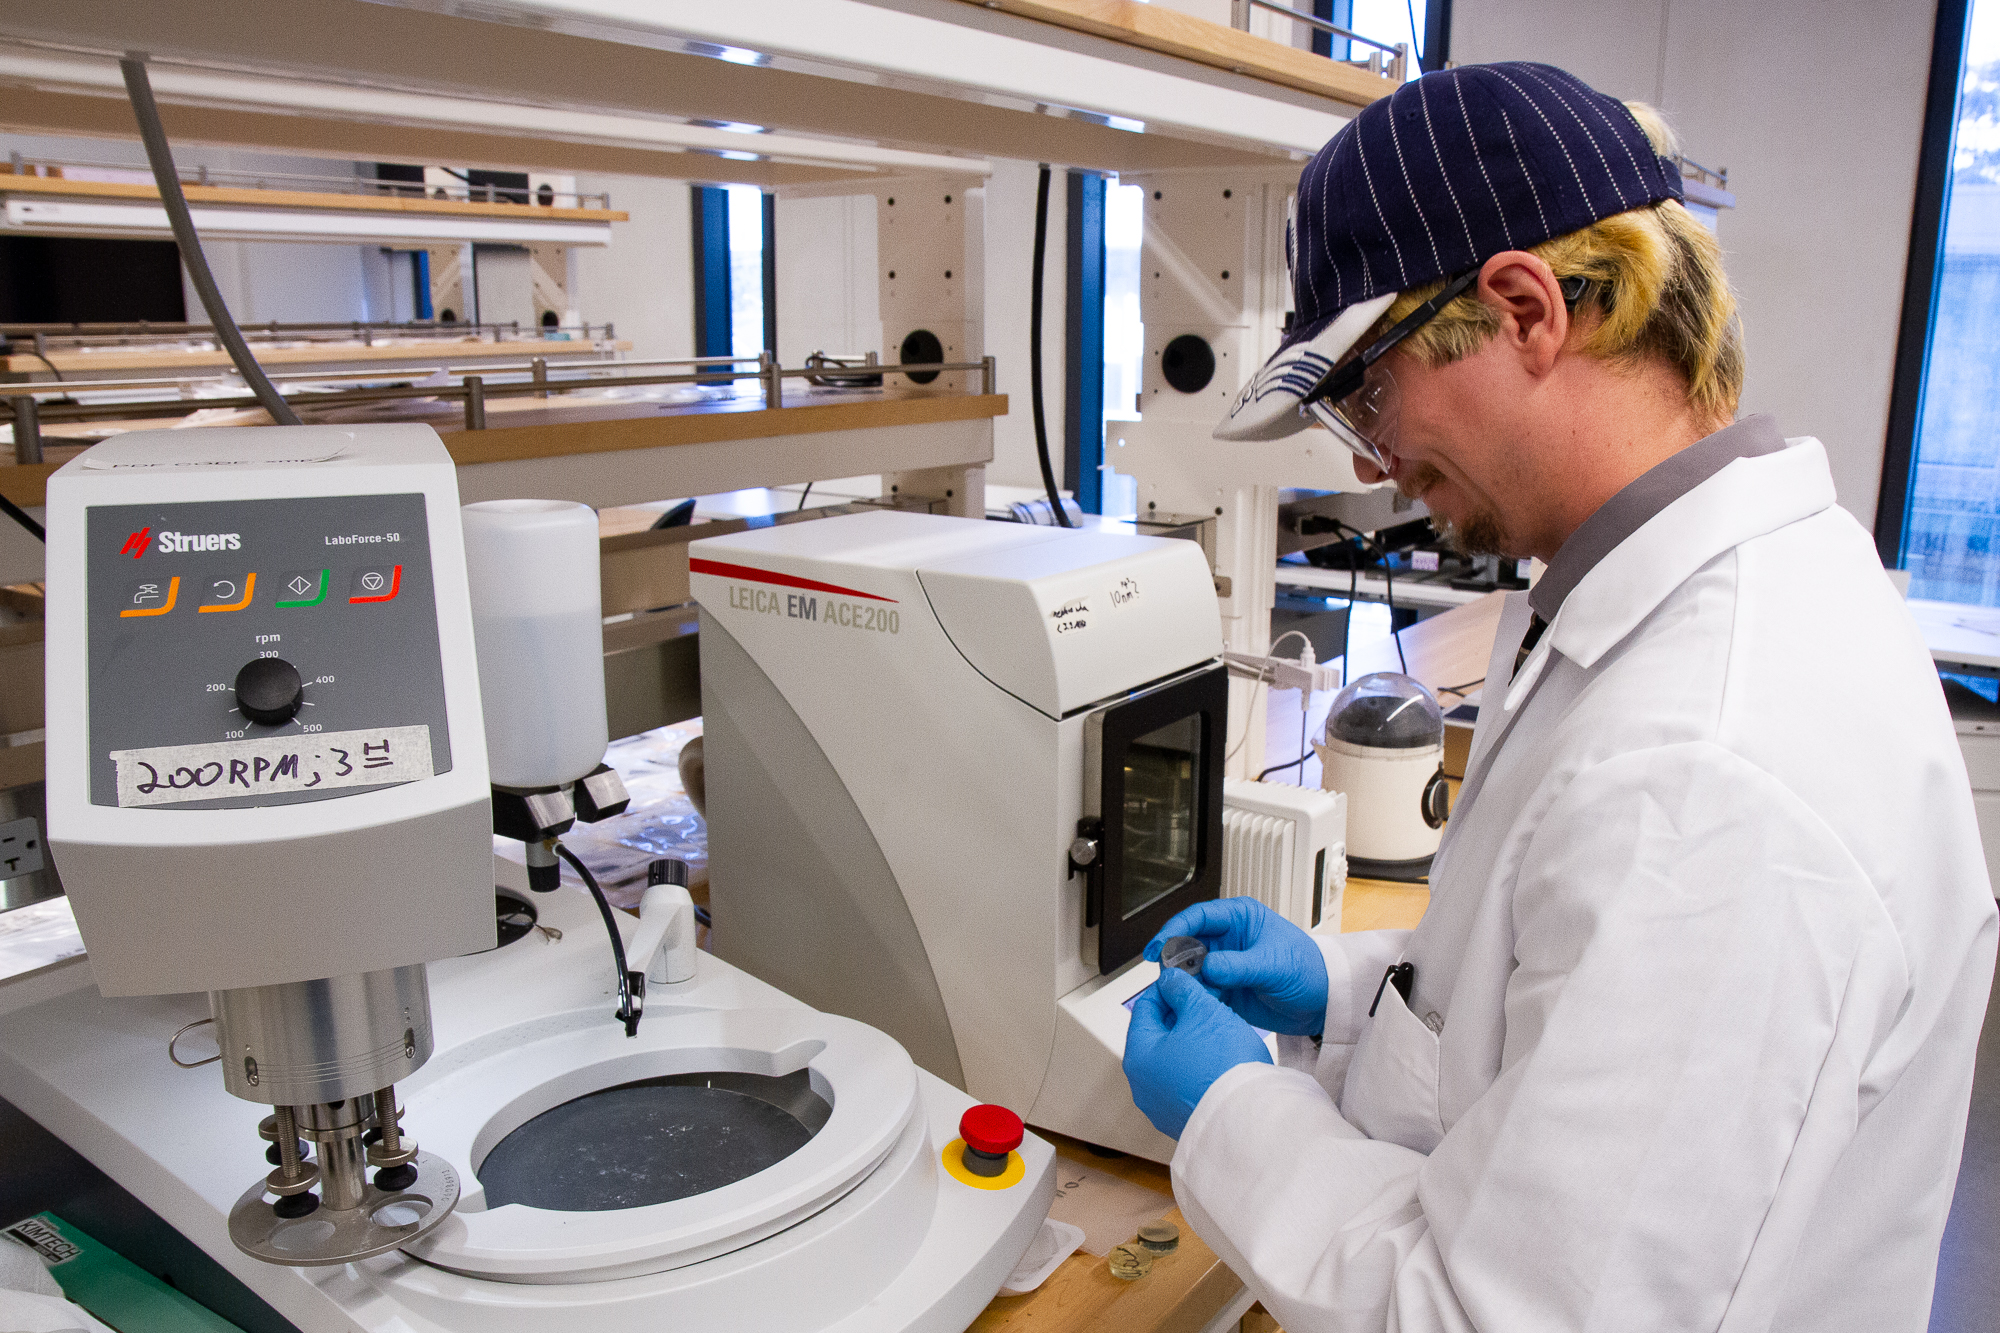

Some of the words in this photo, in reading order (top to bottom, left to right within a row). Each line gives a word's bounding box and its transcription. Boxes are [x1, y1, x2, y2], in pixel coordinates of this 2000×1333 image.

[158, 531, 241, 553] Struers
[325, 532, 401, 547] LaboForce-50
[729, 585, 781, 616] LEICA
[787, 593, 817, 621] EM
[823, 600, 900, 635] ACE200
[255, 633, 281, 644] rpm
[259, 650, 279, 660] 300
[315, 675, 335, 685] 400
[206, 683, 226, 693] 200
[303, 723, 323, 733] 500
[225, 730, 244, 740] 100
[330, 747, 353, 777] 3
[16, 1220, 81, 1259] KIMTECH
